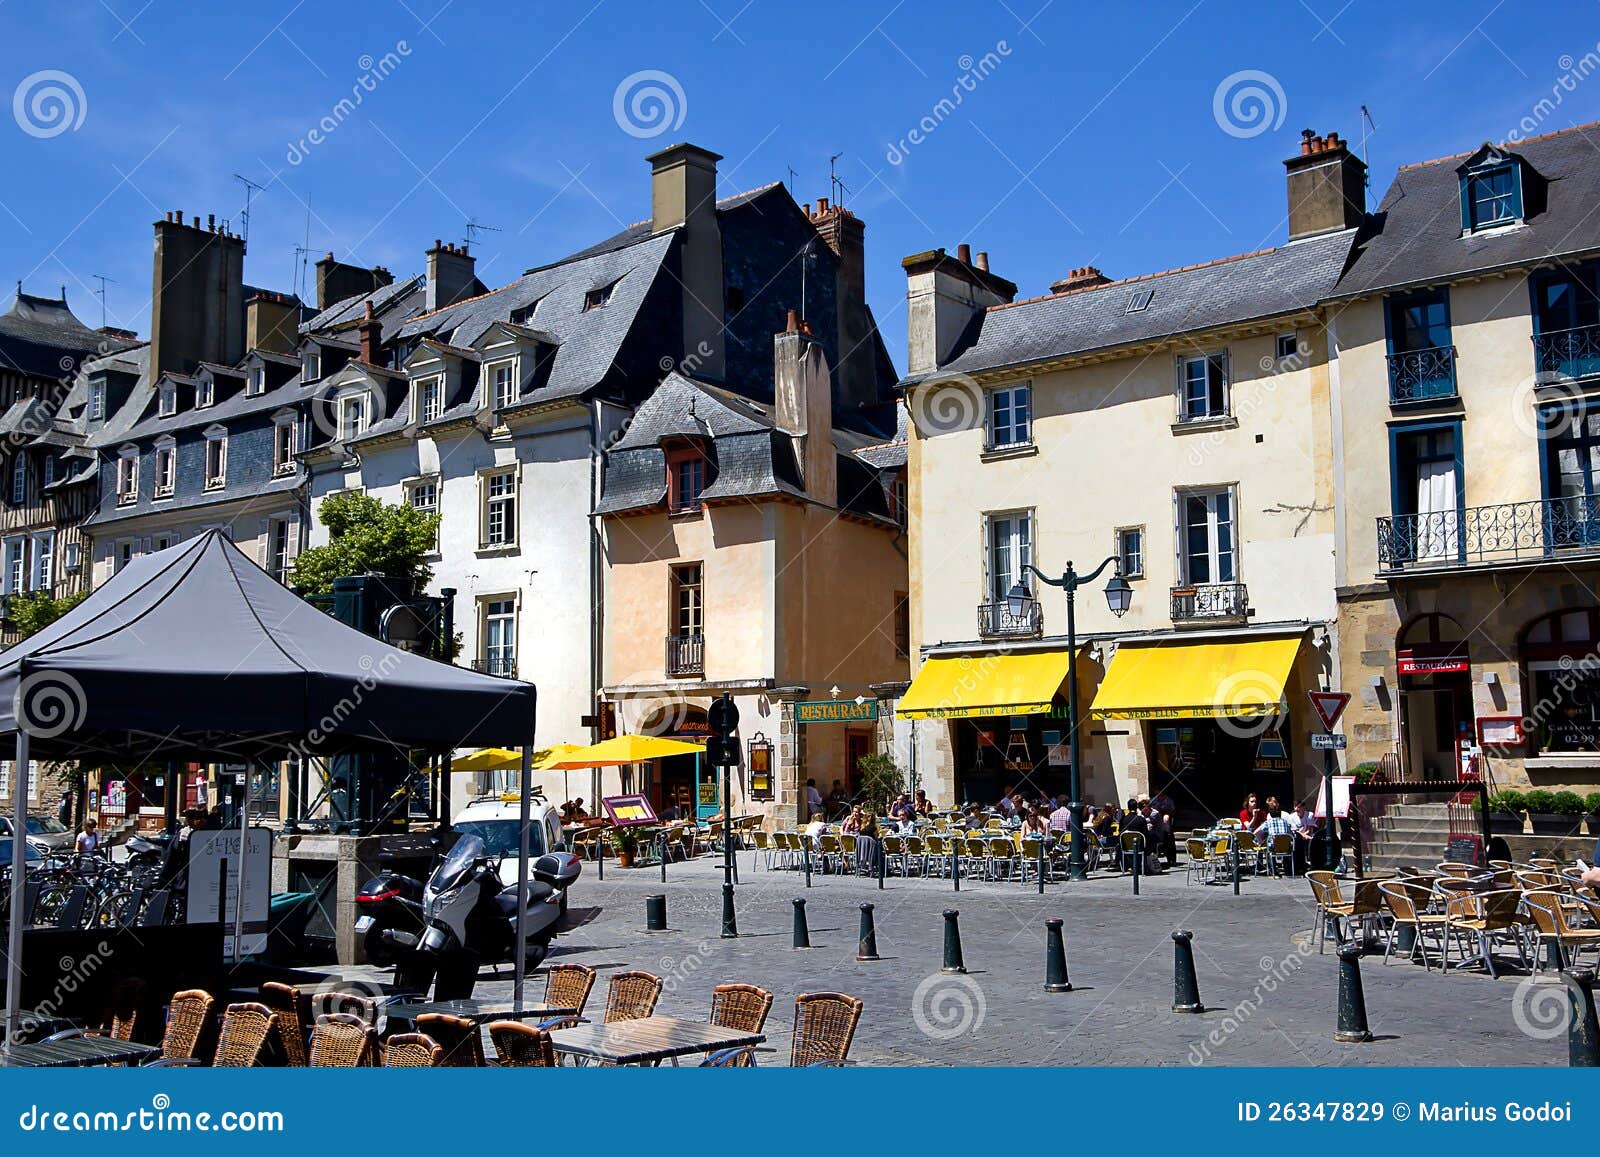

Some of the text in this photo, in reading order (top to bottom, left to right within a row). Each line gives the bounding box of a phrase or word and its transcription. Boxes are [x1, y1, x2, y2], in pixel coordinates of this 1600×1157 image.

[1403, 662, 1463, 671] RESTAURANT
[800, 703, 871, 719] RESTAURANT
[948, 708, 969, 717] ELLIS
[979, 706, 995, 716] BAR
[1000, 705, 1017, 714] PUB
[1127, 707, 1238, 719] WEBB ELLIS BAR PUB
